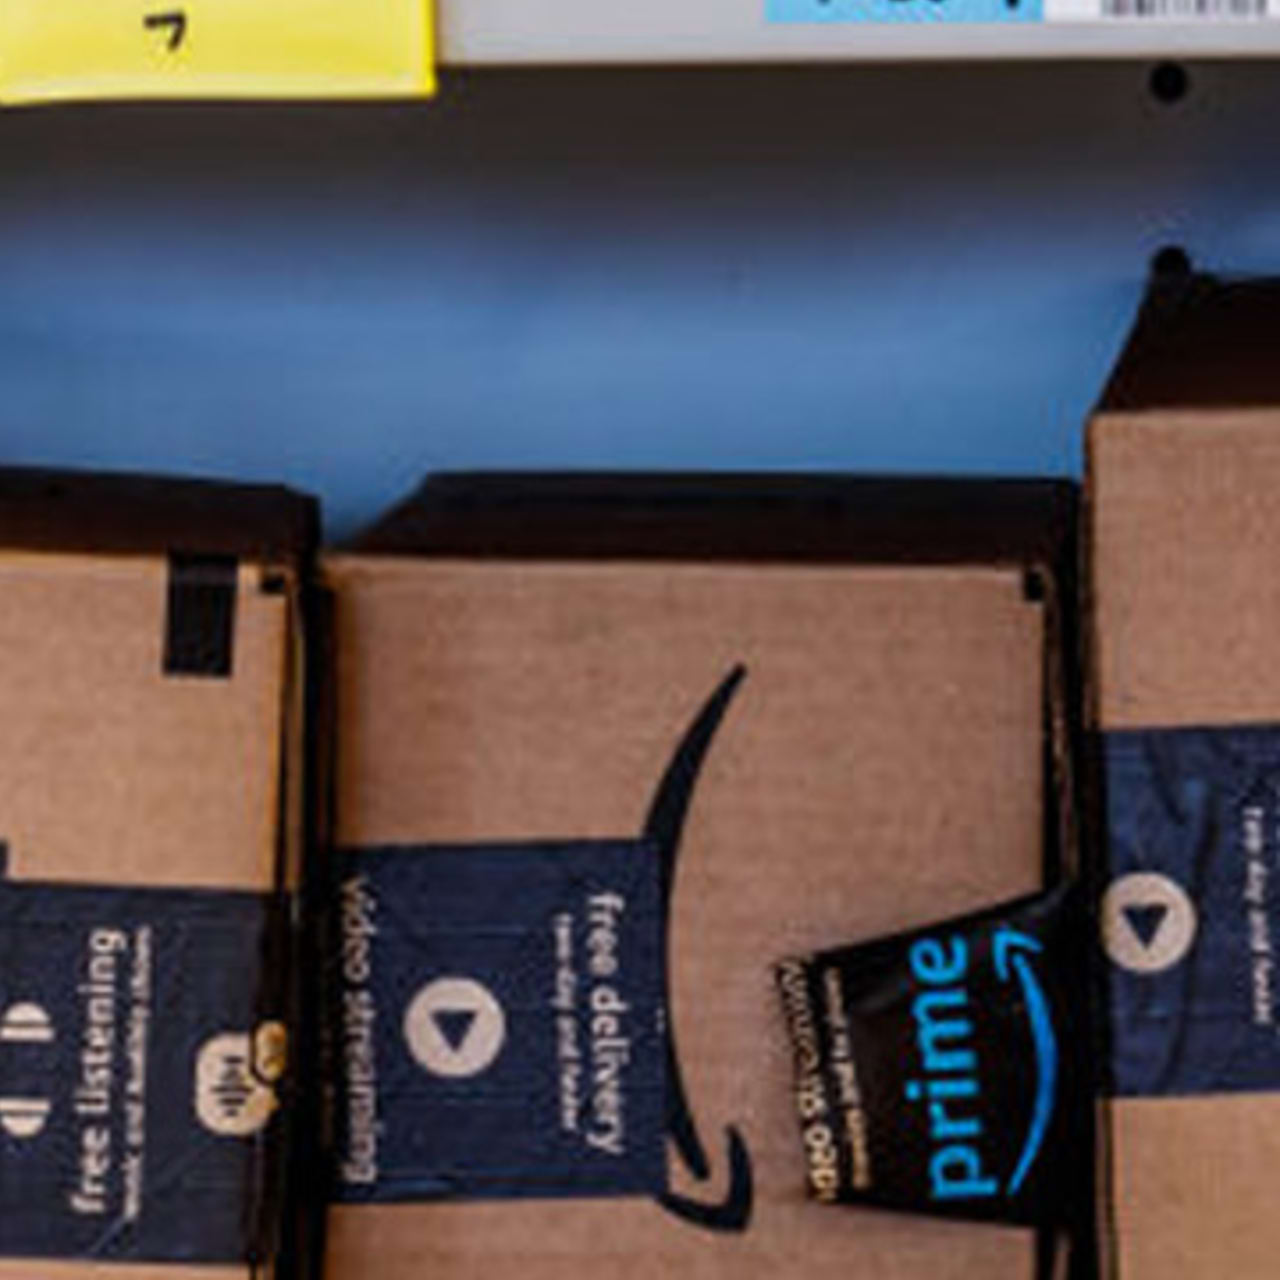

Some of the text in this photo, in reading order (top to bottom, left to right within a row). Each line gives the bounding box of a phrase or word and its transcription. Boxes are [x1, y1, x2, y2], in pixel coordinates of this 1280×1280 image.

[69, 928, 128, 1214] free listening
[340, 874, 386, 1185] video streaming
[585, 891, 632, 1156] free delivery
[905, 934, 1000, 1200] prime
